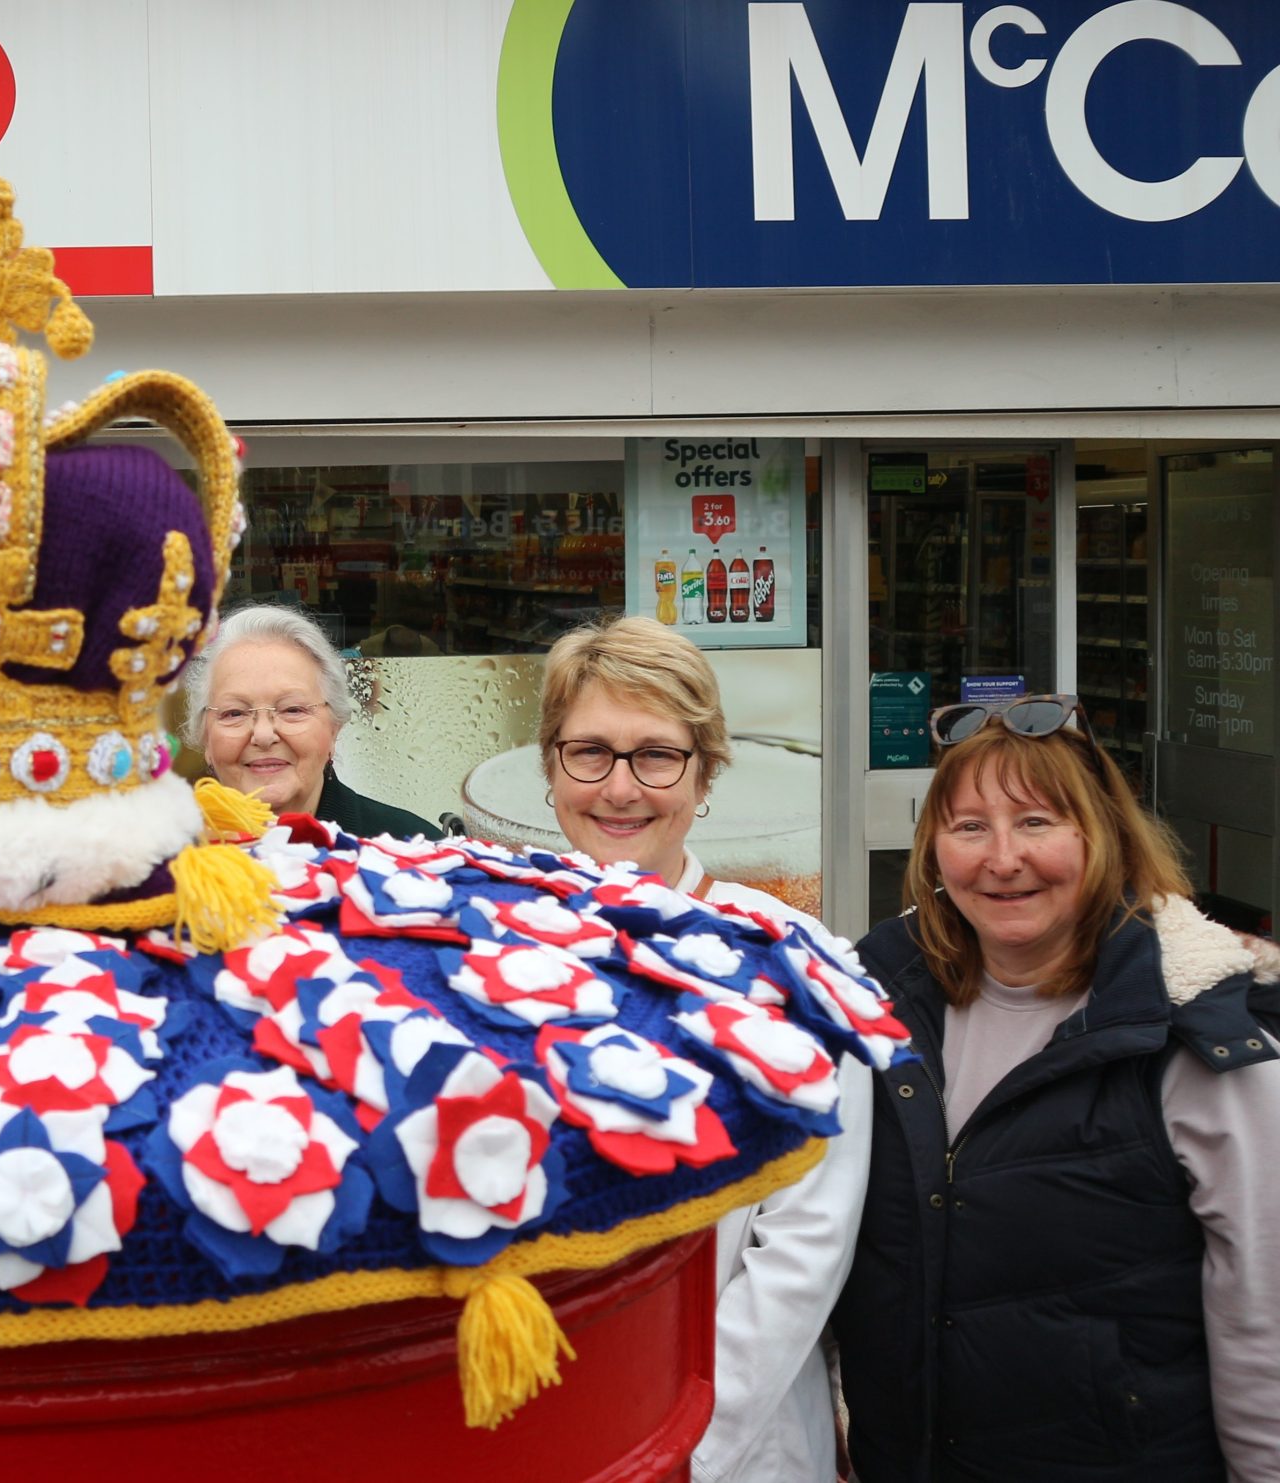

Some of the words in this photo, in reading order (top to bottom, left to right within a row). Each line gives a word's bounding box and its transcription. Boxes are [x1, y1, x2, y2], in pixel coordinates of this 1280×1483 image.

[748, 0, 1280, 222] McC
[665, 438, 760, 468] Special
[675, 465, 752, 488] offers
[703, 502, 710, 510] 2
[711, 502, 723, 510] for
[1191, 562, 1248, 586] Opening
[682, 578, 704, 595] Sprite
[1201, 592, 1239, 612] times
[1184, 625, 1213, 645] Mon
[1216, 627, 1230, 647] to
[1233, 628, 1257, 649] Sat
[1195, 686, 1245, 713] Sunday
[1188, 708, 1255, 736] 7am-1pm
